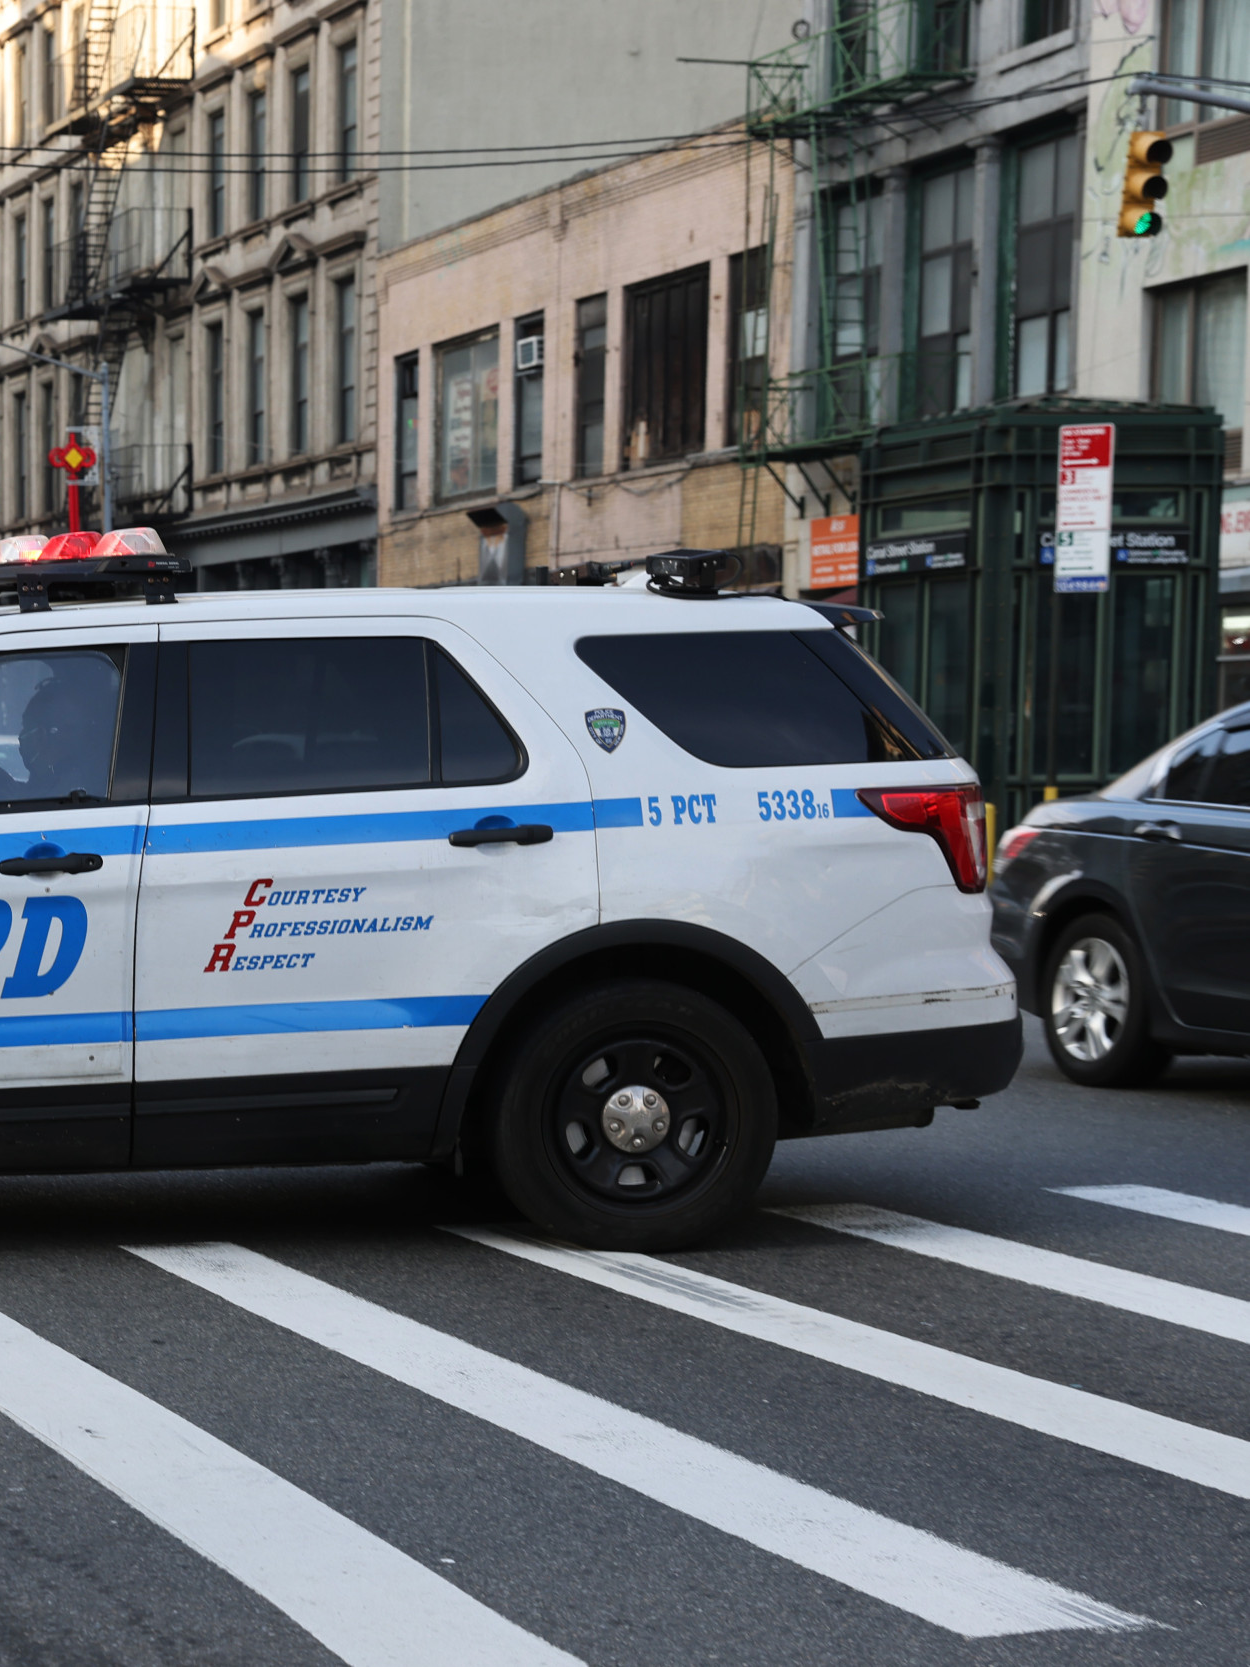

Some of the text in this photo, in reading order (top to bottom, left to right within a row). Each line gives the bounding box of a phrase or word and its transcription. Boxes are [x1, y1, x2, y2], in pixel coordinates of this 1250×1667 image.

[1125, 531, 1176, 547] Station
[647, 793, 717, 827] 5 PCT
[757, 788, 830, 822] 5338 16
